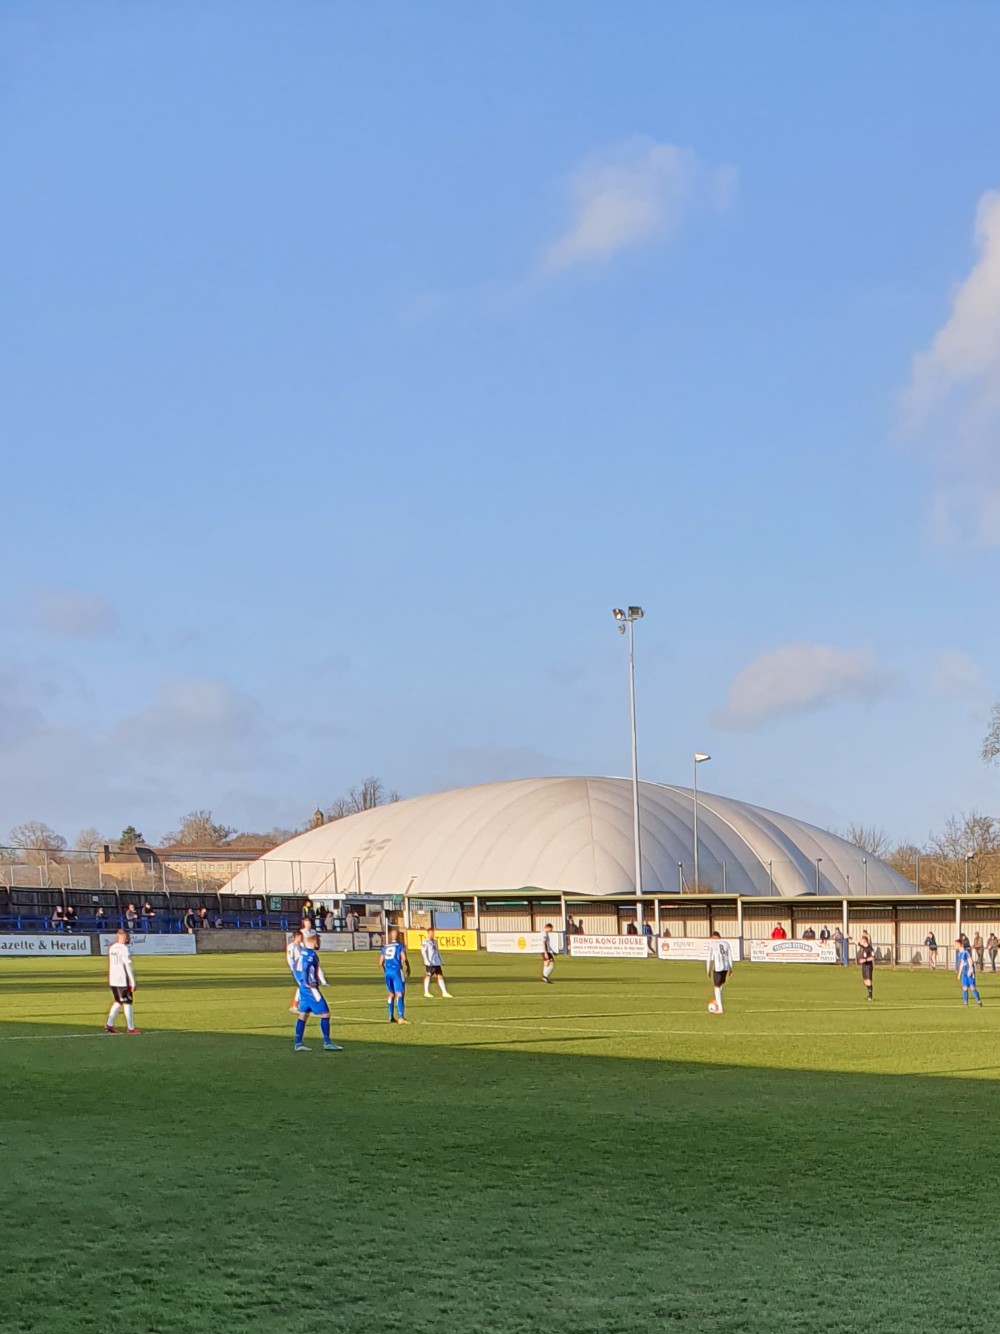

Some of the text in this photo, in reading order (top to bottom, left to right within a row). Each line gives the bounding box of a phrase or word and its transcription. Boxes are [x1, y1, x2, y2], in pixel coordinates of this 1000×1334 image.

[0, 939, 87, 951] azette & Herald
[418, 934, 467, 947] TTCHERS
[573, 936, 644, 945] HONG KONG HOUSE
[385, 946, 396, 960] 9
[719, 943, 726, 955] 8
